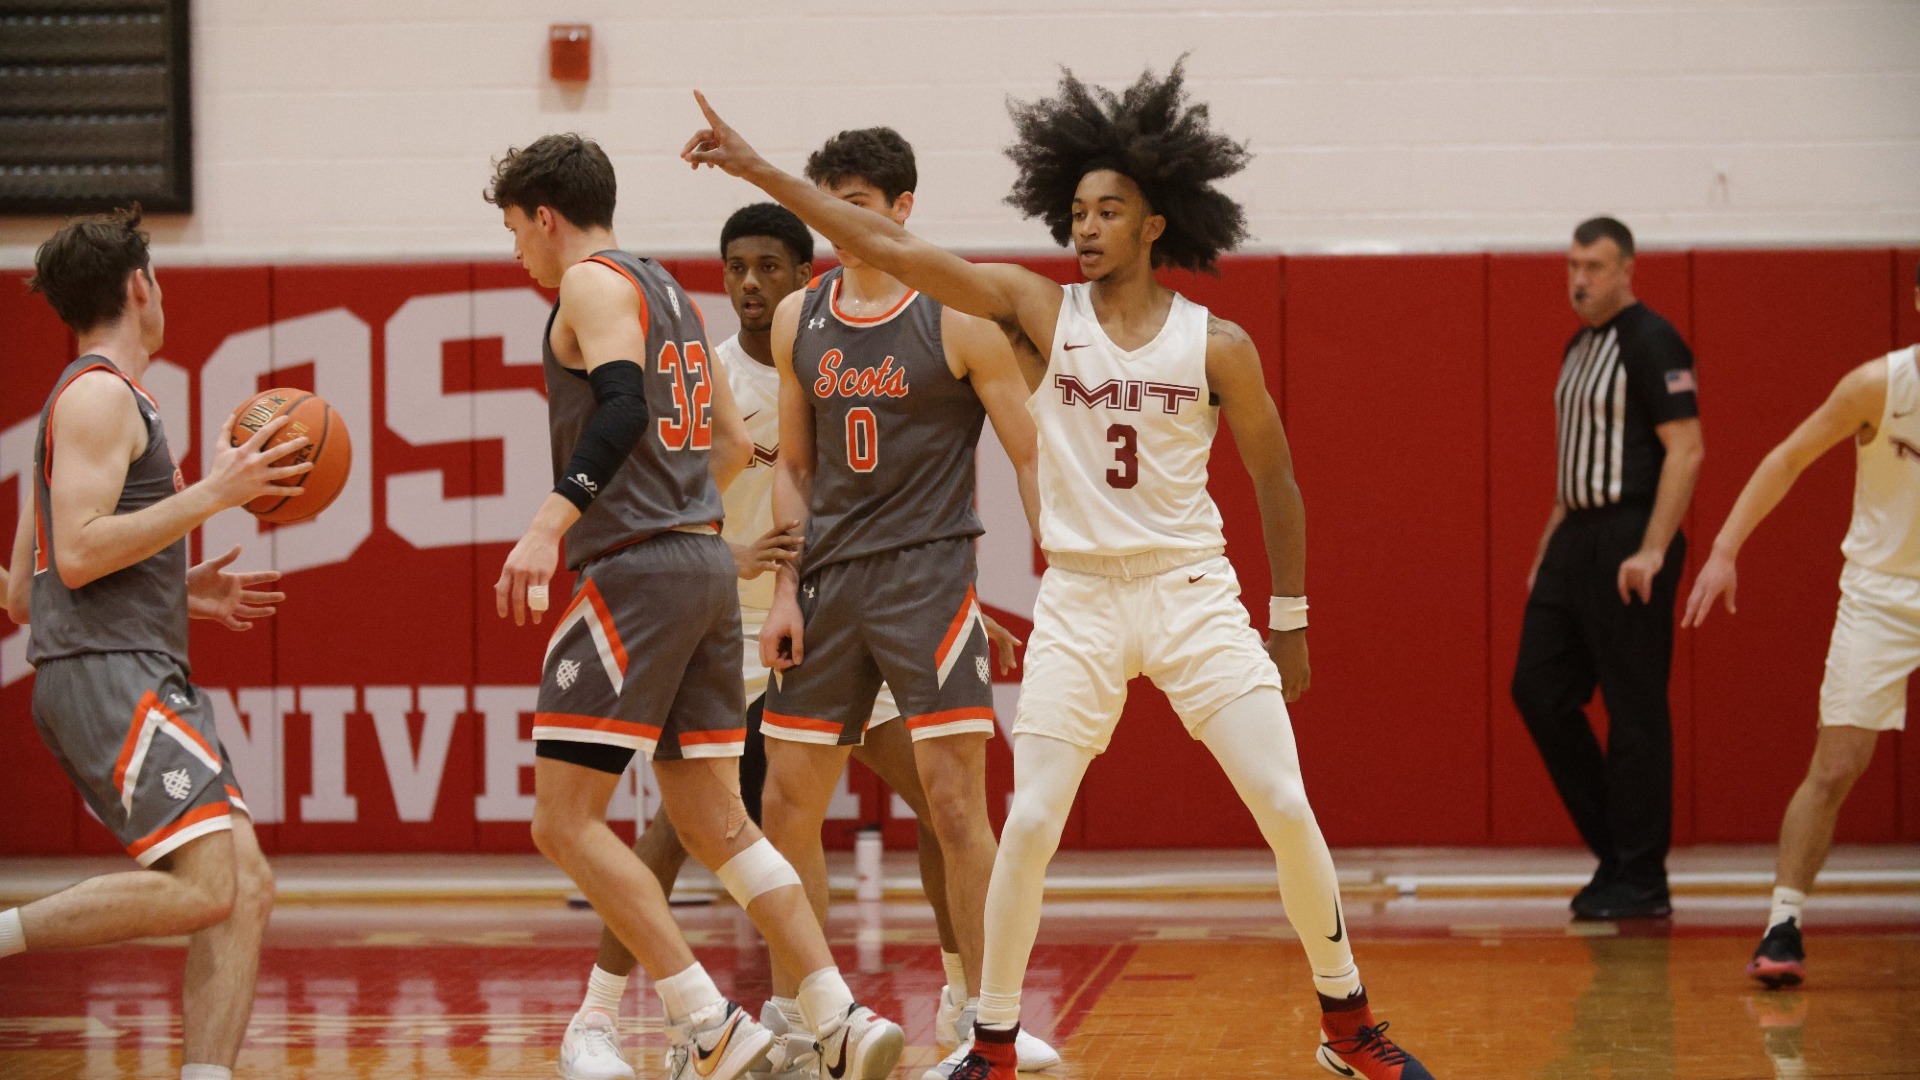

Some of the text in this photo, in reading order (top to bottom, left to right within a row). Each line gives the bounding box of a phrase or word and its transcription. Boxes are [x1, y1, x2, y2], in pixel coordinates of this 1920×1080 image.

[658, 340, 712, 451] 32
[814, 348, 909, 398] Scots
[1055, 374, 1199, 415] MIT
[845, 407, 878, 473] 0
[1106, 424, 1138, 489] 3
